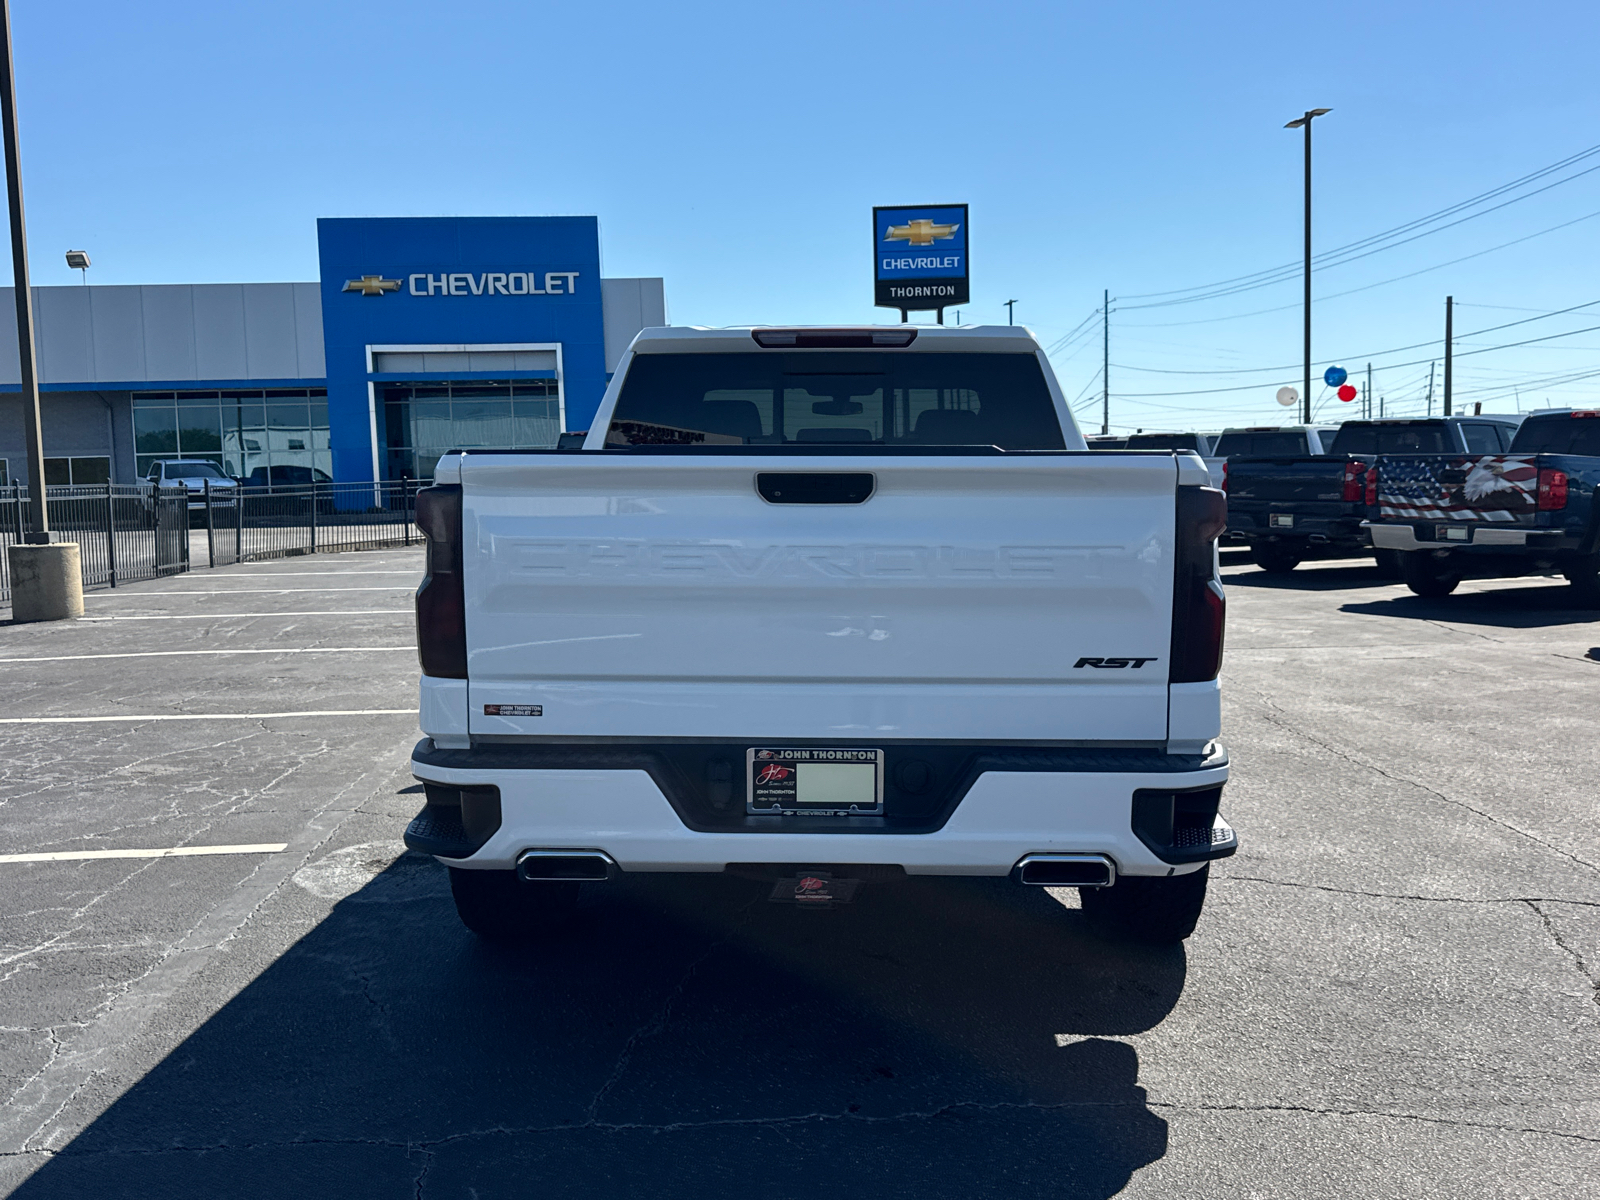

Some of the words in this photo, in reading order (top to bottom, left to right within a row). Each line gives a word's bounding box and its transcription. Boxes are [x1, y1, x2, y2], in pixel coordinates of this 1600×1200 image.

[882, 256, 961, 270] CHEVROLET
[408, 271, 580, 296] CHEVROLET
[889, 285, 955, 297] THORNTON
[1072, 657, 1159, 669] RST
[779, 750, 810, 759] JOHN
[812, 750, 875, 760] THORNTON
